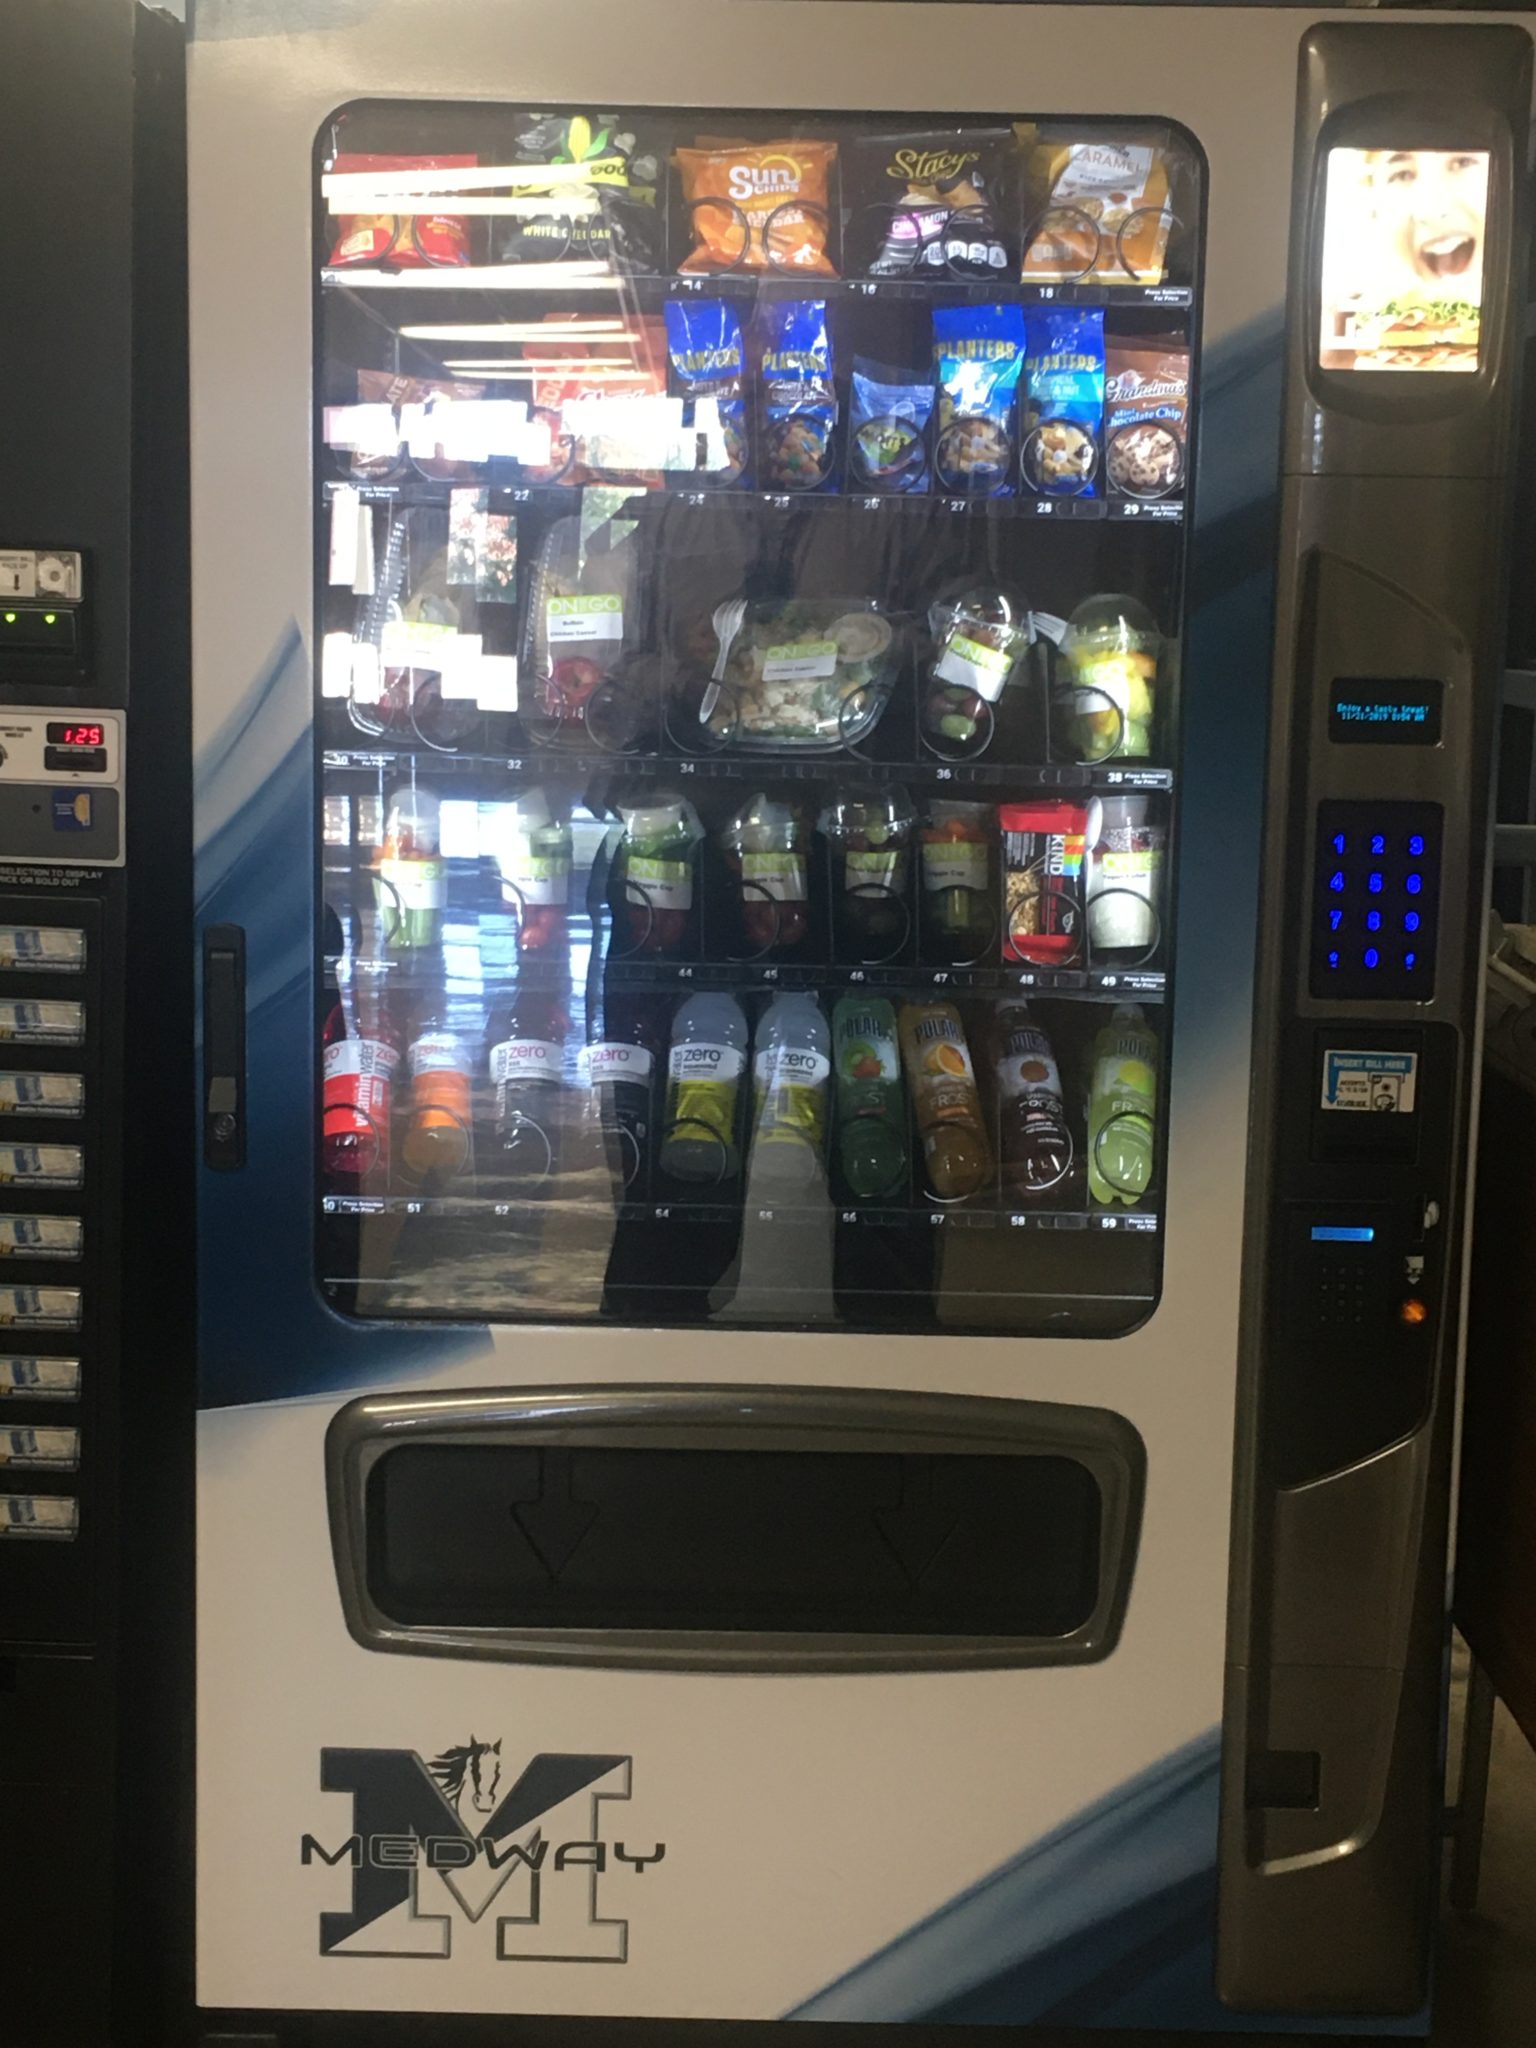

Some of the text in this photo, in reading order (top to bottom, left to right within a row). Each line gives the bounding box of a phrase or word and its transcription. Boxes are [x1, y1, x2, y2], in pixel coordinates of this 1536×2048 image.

[729, 165, 802, 199] Sun
[1039, 288, 1054, 298] 18
[951, 501, 966, 511] 27
[1037, 502, 1052, 513] 28
[1124, 504, 1140, 515] 29
[507, 759, 521, 770] 32
[680, 763, 695, 773] 34
[936, 769, 951, 780] 36
[1108, 772, 1122, 783] 38
[1333, 833, 1424, 856] 1 2 3
[1050, 835, 1065, 875] KIND
[51, 868, 63, 877] TO
[65, 870, 103, 879] DISPLAY
[19, 876, 33, 884] OR
[35, 877, 60, 886] SOLD
[61, 878, 81, 887] OUT
[1330, 871, 1422, 894] 4 5 6
[1329, 909, 1420, 932] 7 8 9
[1364, 948, 1379, 969] 0
[678, 969, 692, 978] 44
[763, 969, 777, 980] 45
[933, 973, 948, 983] 47
[1019, 974, 1034, 984] 48
[1101, 976, 1116, 986] 49
[508, 1045, 546, 1059] zero
[592, 1048, 629, 1063] zero
[683, 1048, 721, 1062] zero
[779, 1053, 817, 1070] zero
[407, 1203, 421, 1213] 51
[495, 1205, 509, 1215] 52
[655, 1209, 669, 1219] 54
[759, 1211, 773, 1221] 55
[931, 1215, 944, 1224] 57
[1011, 1216, 1025, 1226] 58
[1102, 1217, 1117, 1229] 59
[301, 1833, 666, 1874] MEDWAY
